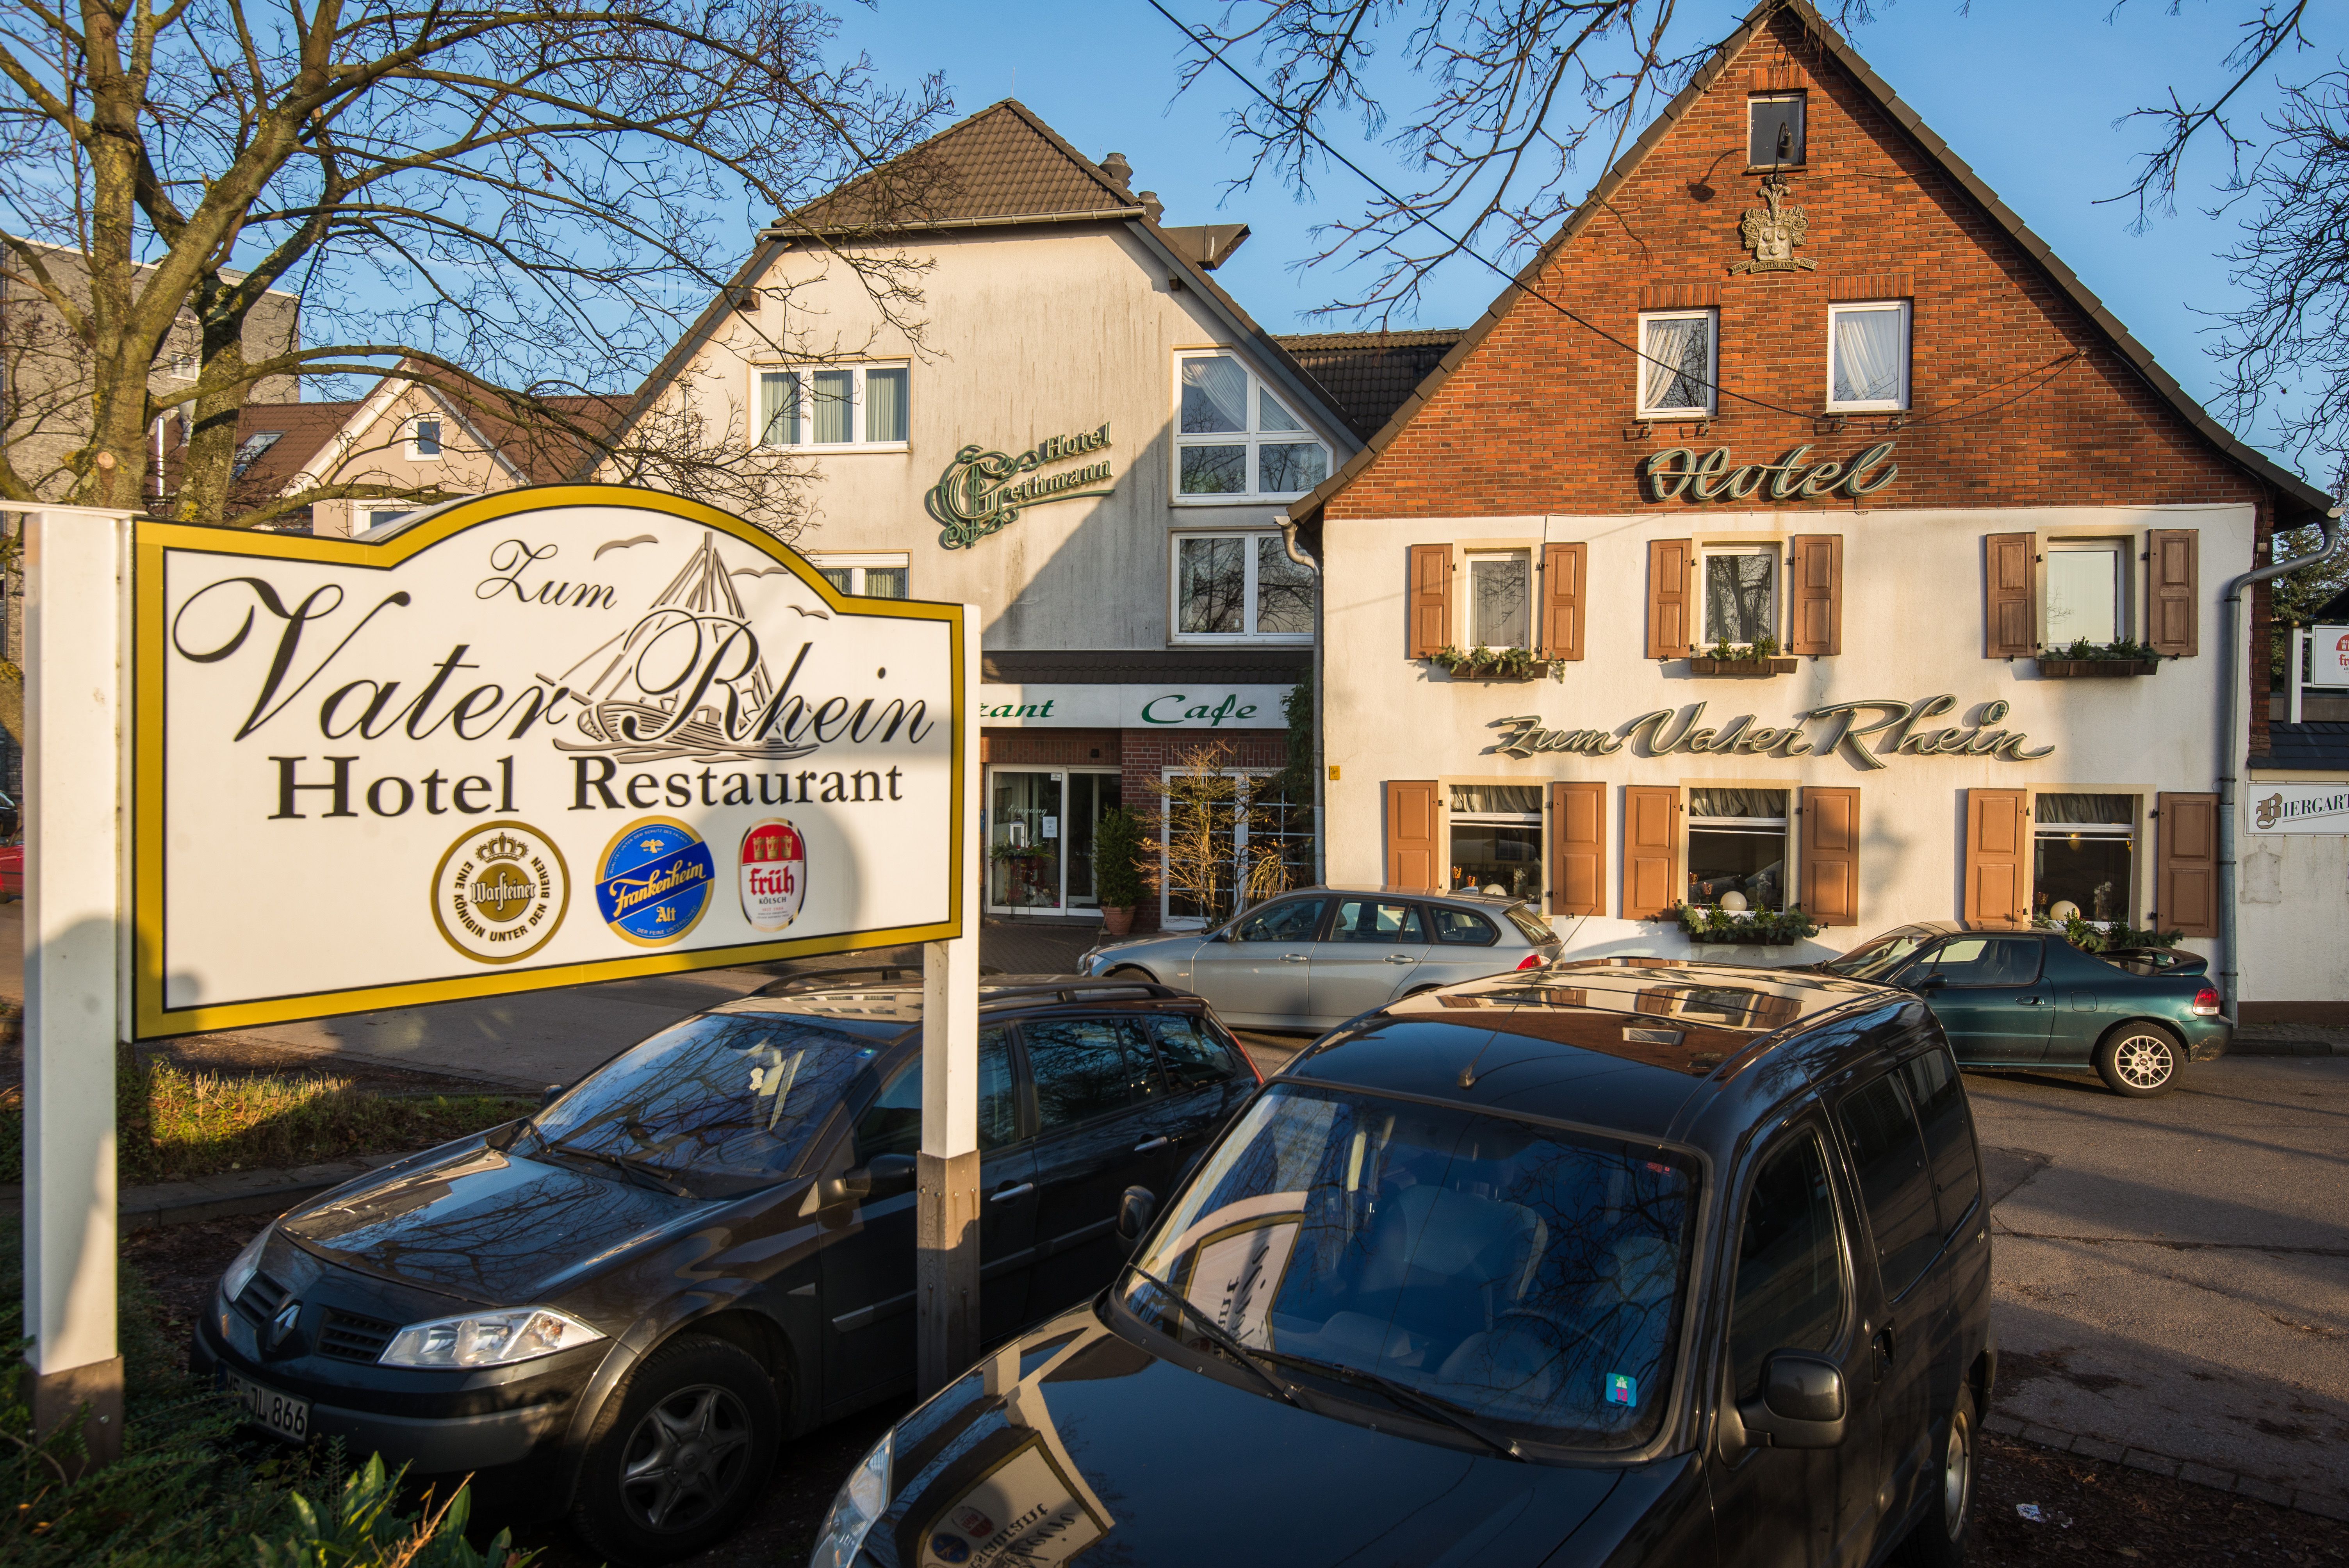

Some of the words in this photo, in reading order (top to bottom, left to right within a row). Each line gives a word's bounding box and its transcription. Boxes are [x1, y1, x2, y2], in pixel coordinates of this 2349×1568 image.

[1044, 421, 1112, 462] Hotel
[1647, 441, 1898, 501] Hotel
[476, 540, 617, 609] Zum
[172, 576, 570, 742] Vater
[622, 609, 934, 745] Rhein
[1141, 694, 1257, 726] Cafe
[1494, 715, 1624, 757] Zum
[1629, 701, 1814, 756] Vater
[1808, 693, 2055, 769] Rhein
[267, 756, 519, 820] Hotel
[568, 756, 903, 810] Restaurant
[1008, 804, 1047, 817] Eingang
[454, 861, 474, 890] EINE
[530, 857, 550, 898] BIEREN
[609, 860, 706, 918] Frankenheim
[749, 865, 794, 896] früh
[453, 894, 486, 938] KÖNIGIN
[528, 903, 547, 927] DEN
[656, 906, 676, 924] Alt
[759, 896, 786, 905] KÖLSCH
[490, 925, 529, 941] UNTER
[1615, 1388, 1628, 1402] 13
[273, 1396, 307, 1435] 866
